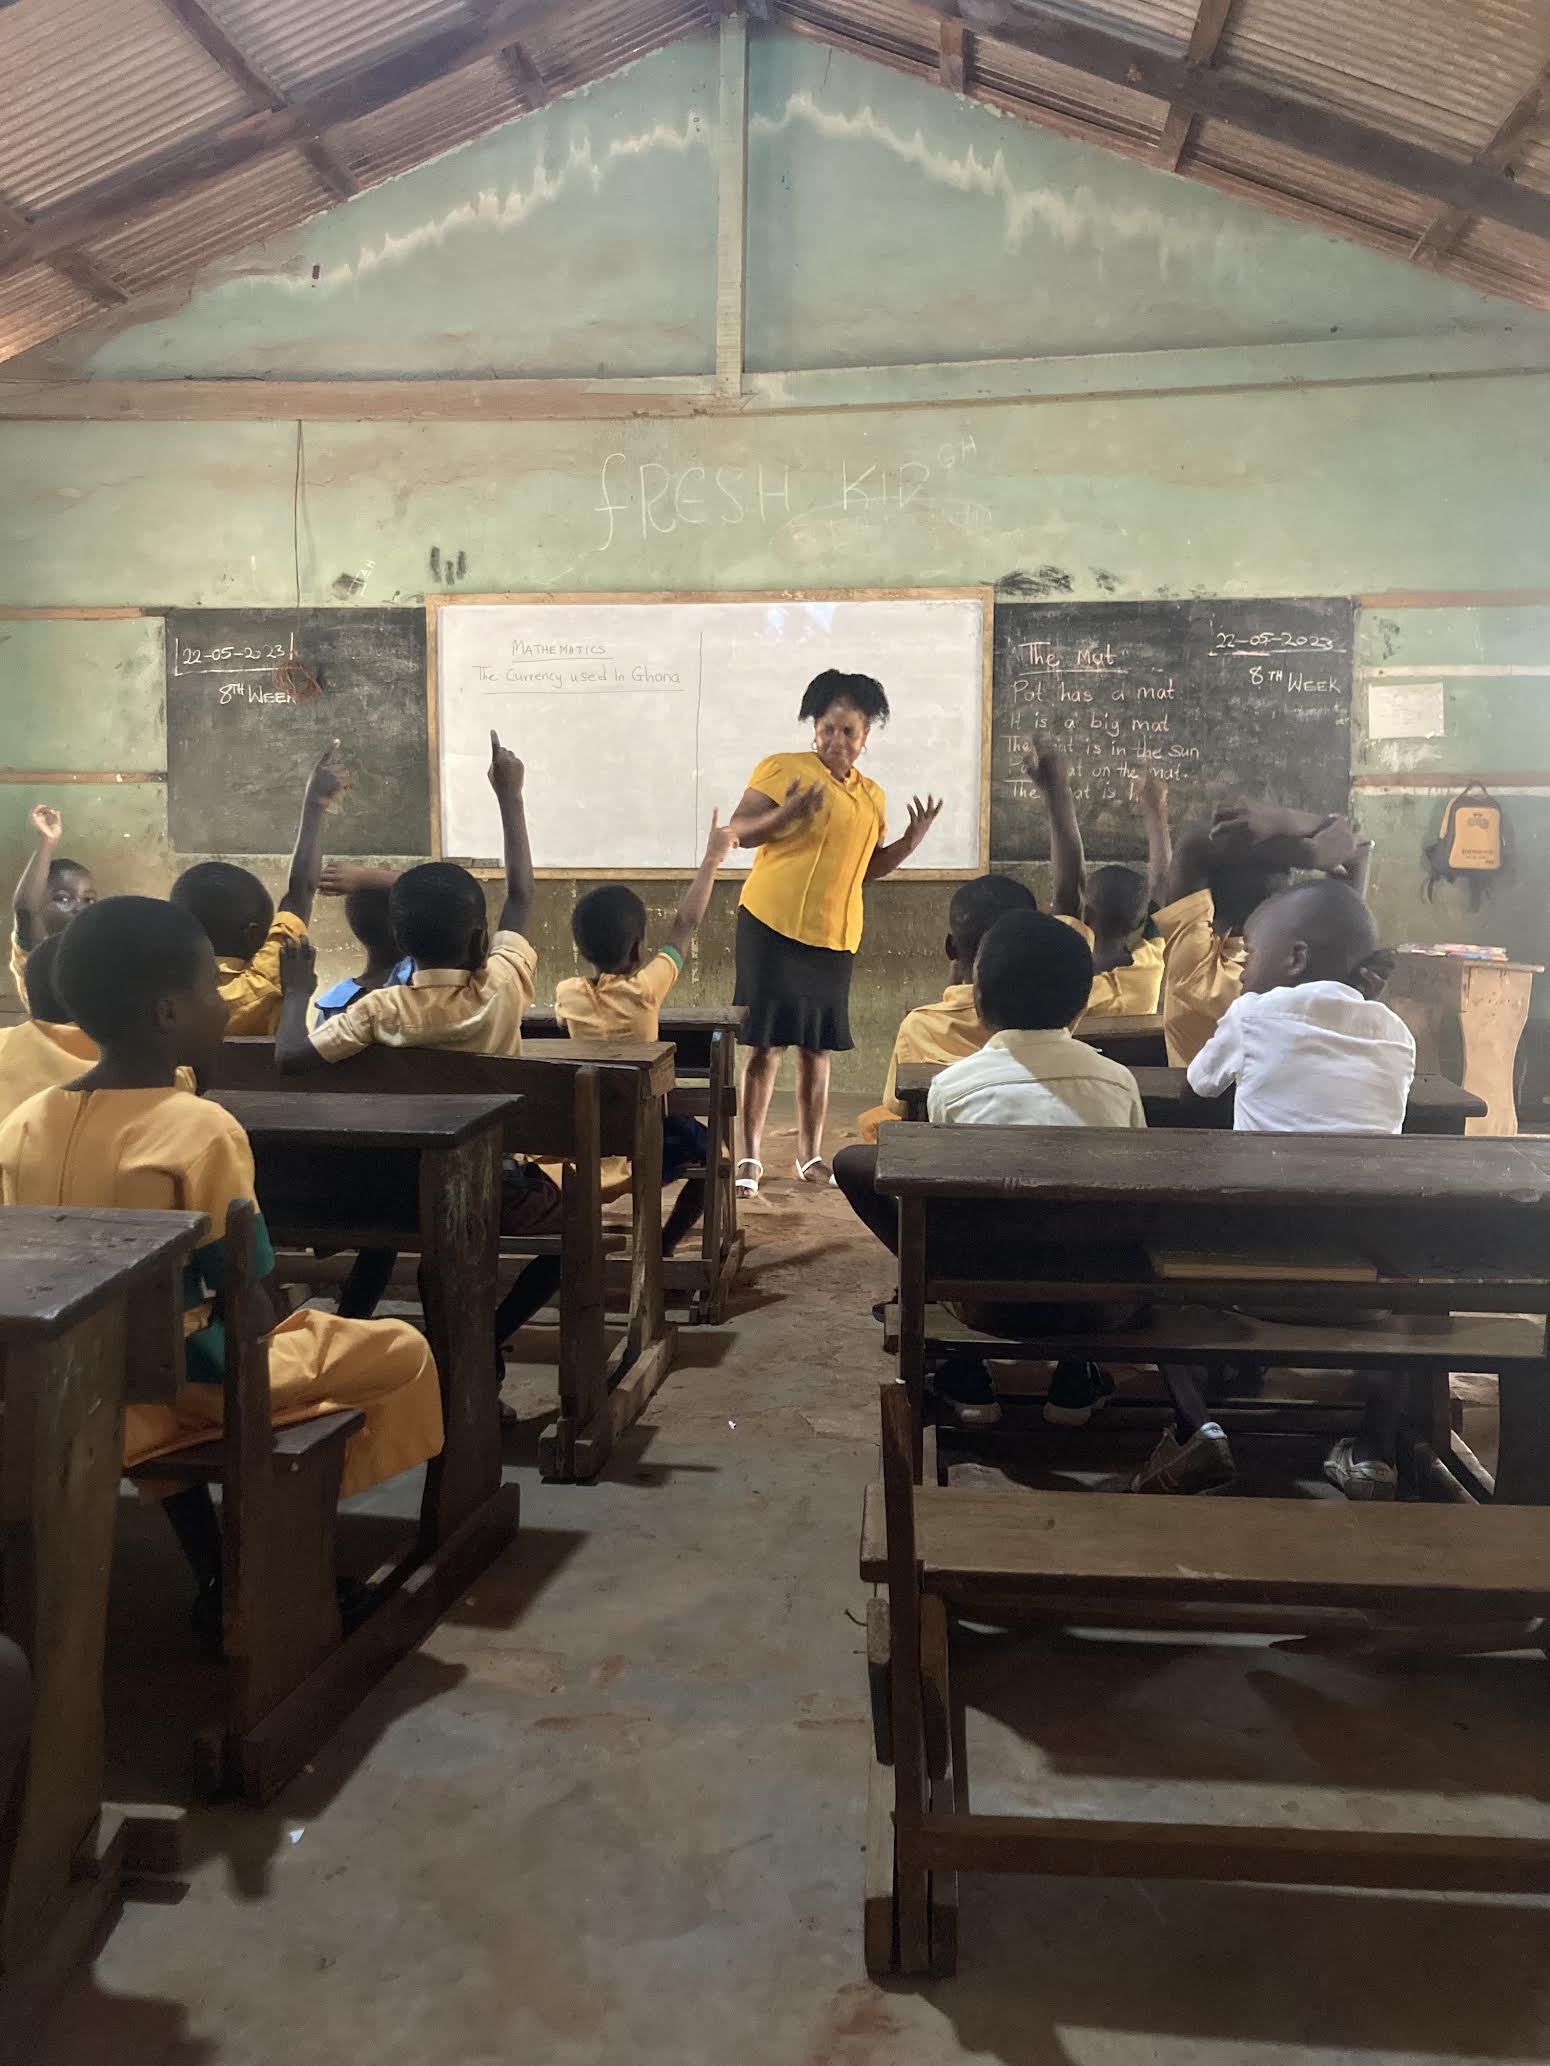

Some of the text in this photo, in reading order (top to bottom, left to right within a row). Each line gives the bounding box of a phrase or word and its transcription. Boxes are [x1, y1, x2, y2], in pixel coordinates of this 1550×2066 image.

[511, 640, 608, 657] MATHEMATICS
[1216, 632, 1333, 650] 22-05-2023
[472, 666, 499, 682] The
[506, 668, 563, 688] Currency
[571, 666, 608, 683] used
[631, 666, 681, 684] Ghana
[1287, 672, 1341, 693] WEEK
[1061, 681, 1094, 702] has
[1112, 690, 1125, 701] a
[1137, 678, 1176, 701] mat
[1034, 711, 1048, 729] is
[1064, 718, 1076, 729] a
[1090, 712, 1120, 737] big
[1132, 714, 1170, 732] mat
[1086, 738, 1103, 754] is
[1111, 740, 1126, 756] in
[1130, 734, 1163, 759] the
[1117, 761, 1139, 778] the
[1003, 780, 1041, 799] The
[1102, 780, 1116, 798] is
